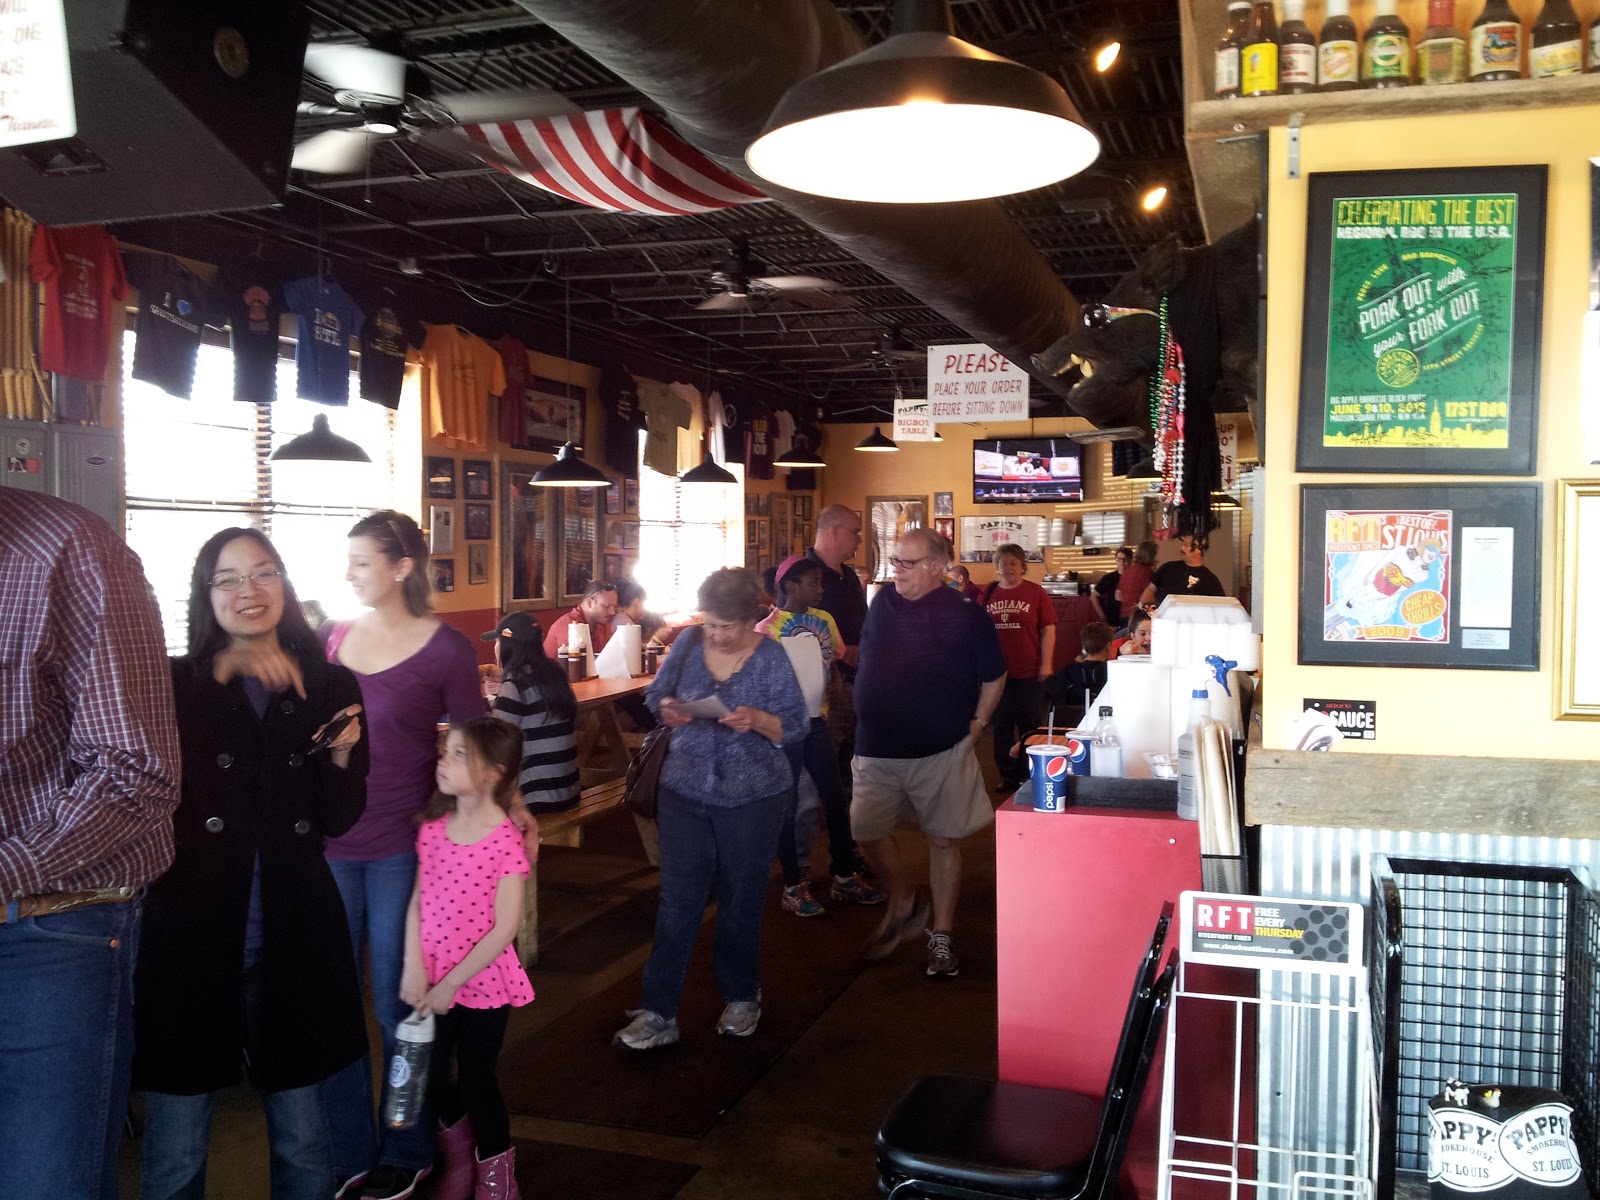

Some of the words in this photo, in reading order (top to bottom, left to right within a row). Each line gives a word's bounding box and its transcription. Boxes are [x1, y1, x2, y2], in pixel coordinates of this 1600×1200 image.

[1338, 200, 1437, 225] CELEBRATING
[1442, 200, 1471, 224] THE
[1475, 199, 1514, 224] BEST
[1446, 226, 1473, 238] THE
[1359, 295, 1401, 334] PORK
[1402, 278, 1433, 311] OUT
[1436, 267, 1468, 292] with
[1373, 331, 1406, 359] your
[1409, 306, 1449, 344] FORK
[1450, 288, 1480, 321] OUT
[944, 353, 1010, 374] PLEASE
[933, 382, 960, 395] PLACE
[964, 381, 987, 395] YOUR
[991, 379, 1022, 394] ORDER
[898, 405, 928, 414] PAPPY'
[932, 402, 962, 415] BEFORE
[965, 401, 995, 415] SITTING
[999, 400, 1023, 414] DOWN
[1330, 403, 1362, 414] JUNE
[1399, 516, 1420, 525] BEST
[986, 600, 1030, 613] INDIANA
[1405, 592, 1435, 612] CHEAP
[1406, 602, 1441, 623] THRILLS
[1369, 627, 1405, 636] 2009
[1329, 711, 1375, 728] SAUCE
[1044, 782, 1055, 809] pepsi
[1255, 907, 1280, 917] FREE
[1255, 917, 1286, 927] EVERY
[1234, 934, 1252, 942] TIMES
[1255, 926, 1305, 939] THURSDAY
[1455, 1164, 1490, 1179] LOUIS
[1550, 1158, 1573, 1172] LOUIS
